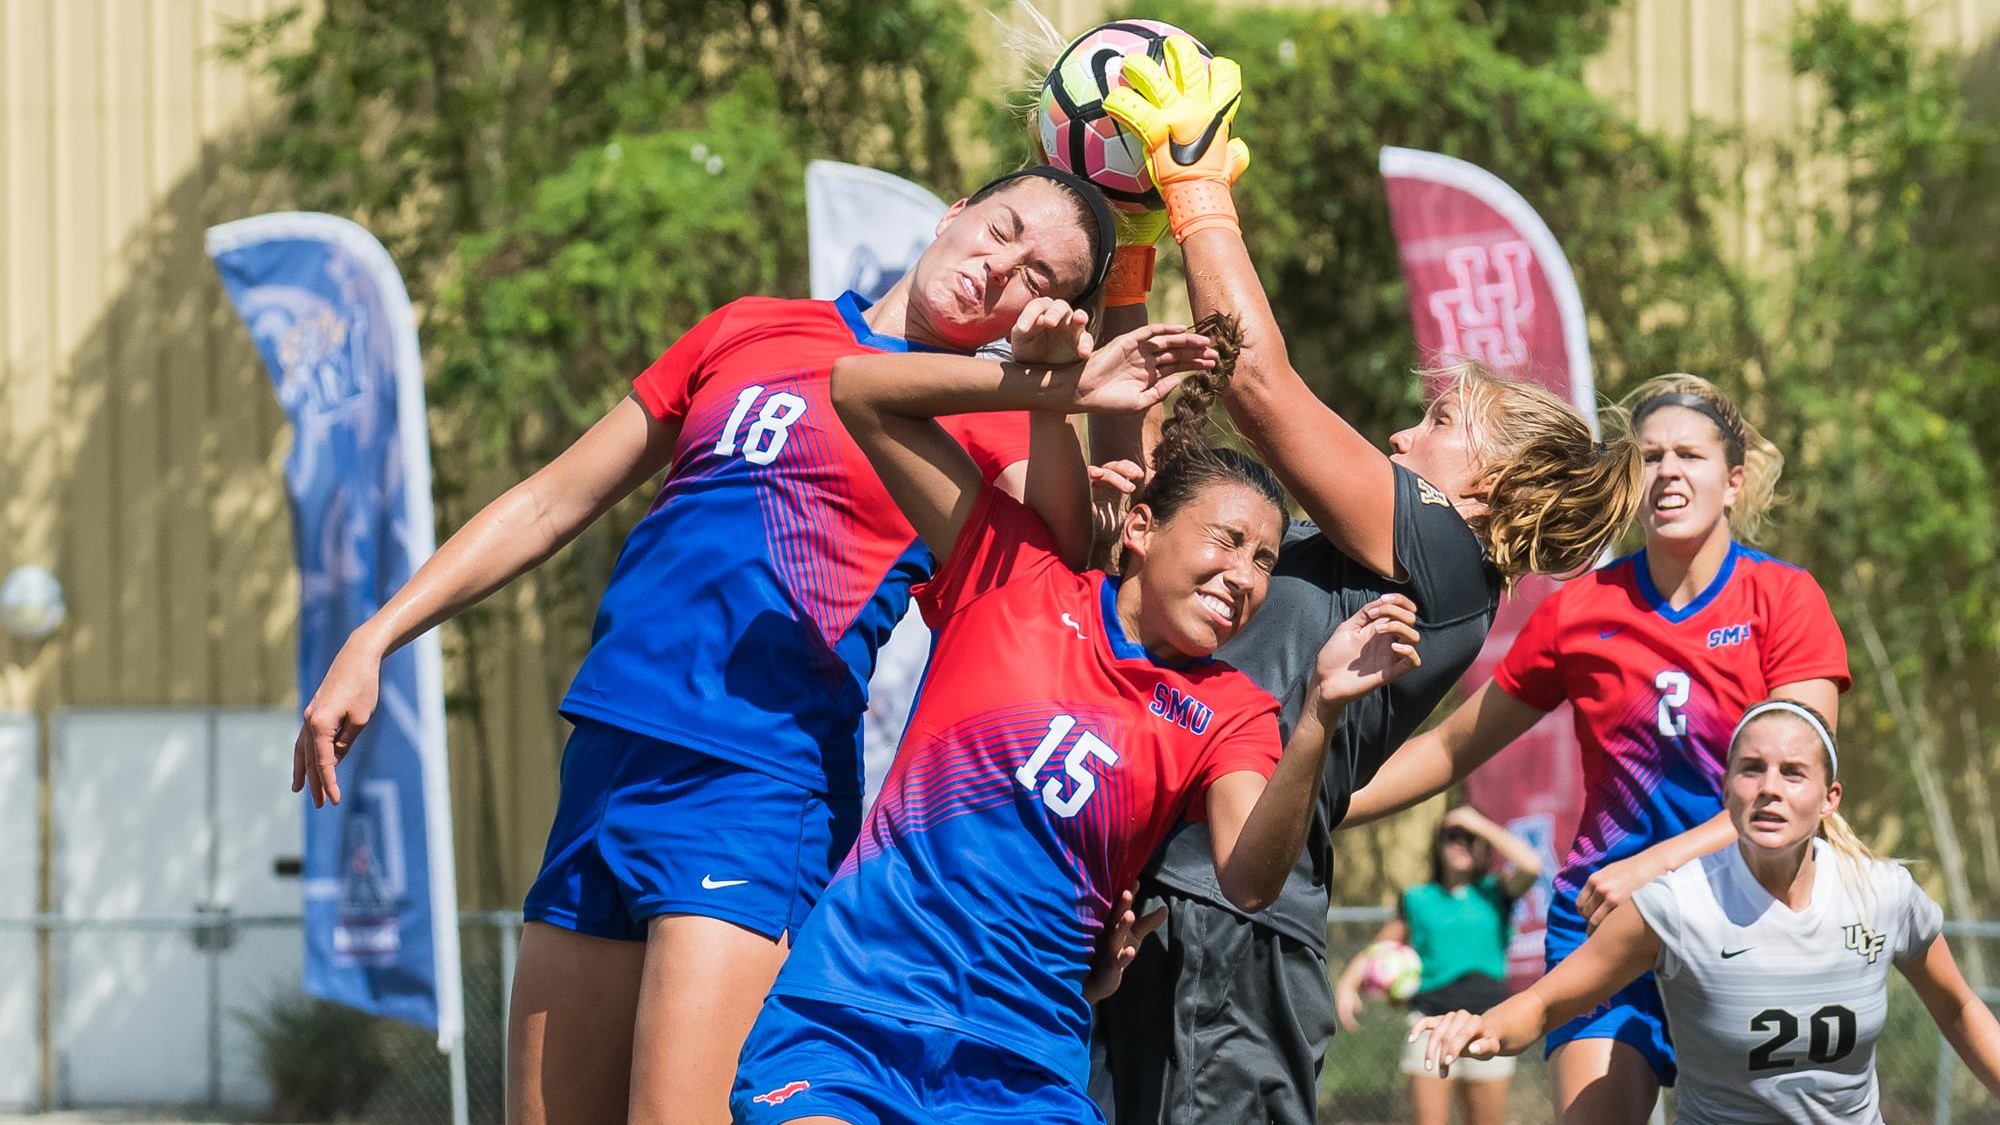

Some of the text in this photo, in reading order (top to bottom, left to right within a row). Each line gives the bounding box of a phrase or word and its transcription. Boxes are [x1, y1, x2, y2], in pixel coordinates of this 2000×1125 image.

[713, 384, 808, 466] 18
[1149, 682, 1215, 736] SMU
[1655, 671, 1690, 737] 2
[1015, 714, 1120, 818] 15
[1841, 923, 1886, 965] UCF
[1748, 1004, 1857, 1071] 20
